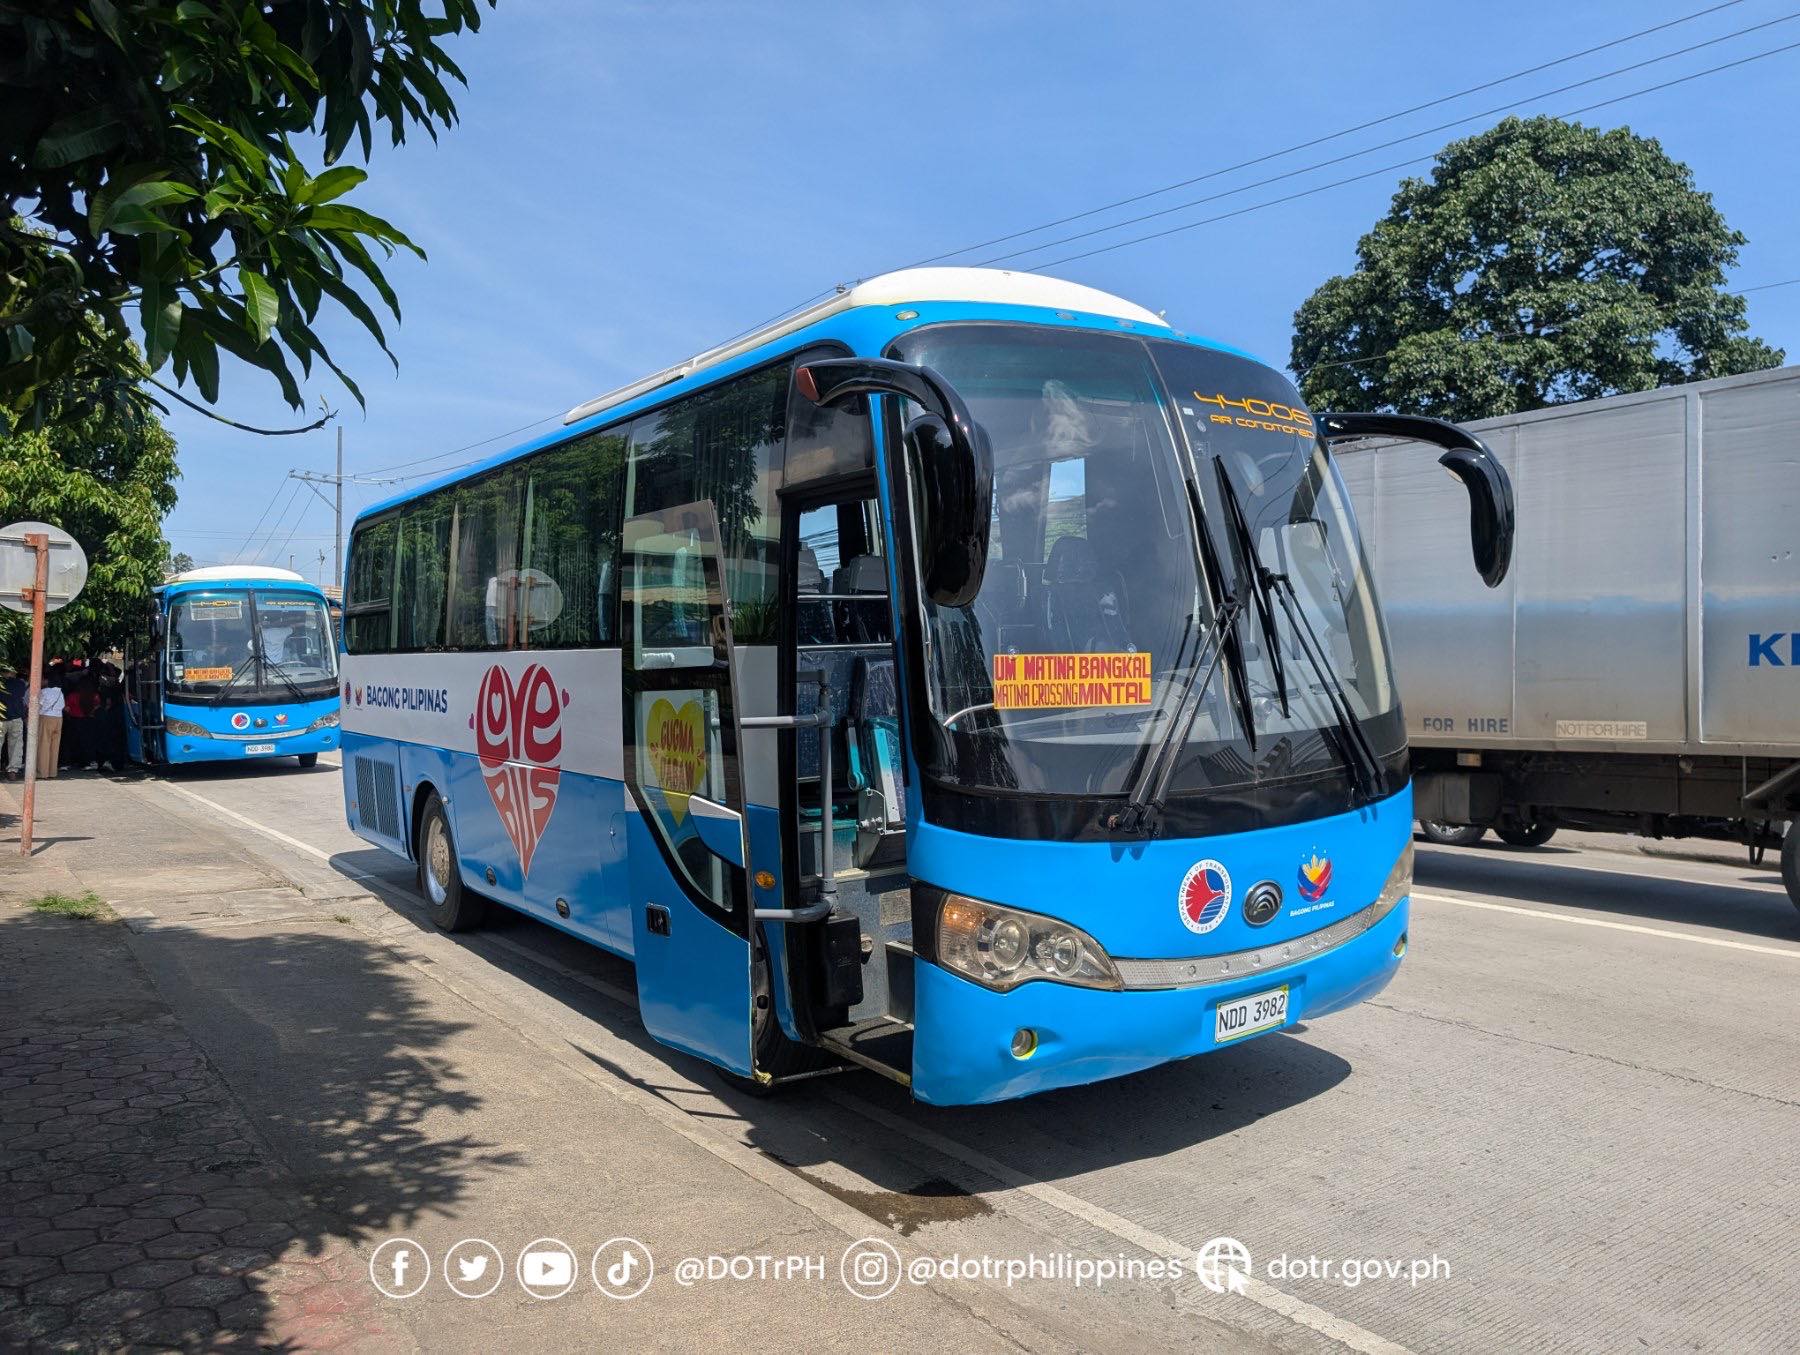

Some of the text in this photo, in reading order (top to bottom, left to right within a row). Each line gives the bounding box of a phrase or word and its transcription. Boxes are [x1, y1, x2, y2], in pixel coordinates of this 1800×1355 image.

[1193, 390, 1313, 427] 44006
[1209, 414, 1233, 425] AIR
[994, 655, 1151, 681] UM MATINA BANGKAL
[402, 687, 448, 714] PILIPINAS
[994, 681, 1152, 708] MATINA CROSSING MINTAL
[661, 718, 695, 753] GUGMA
[1423, 717, 1509, 733] FOR HIRE
[1556, 723, 1646, 737] NOT FOR HIRE
[484, 765, 562, 881] BUS
[1219, 994, 1286, 1033] NDD 3982
